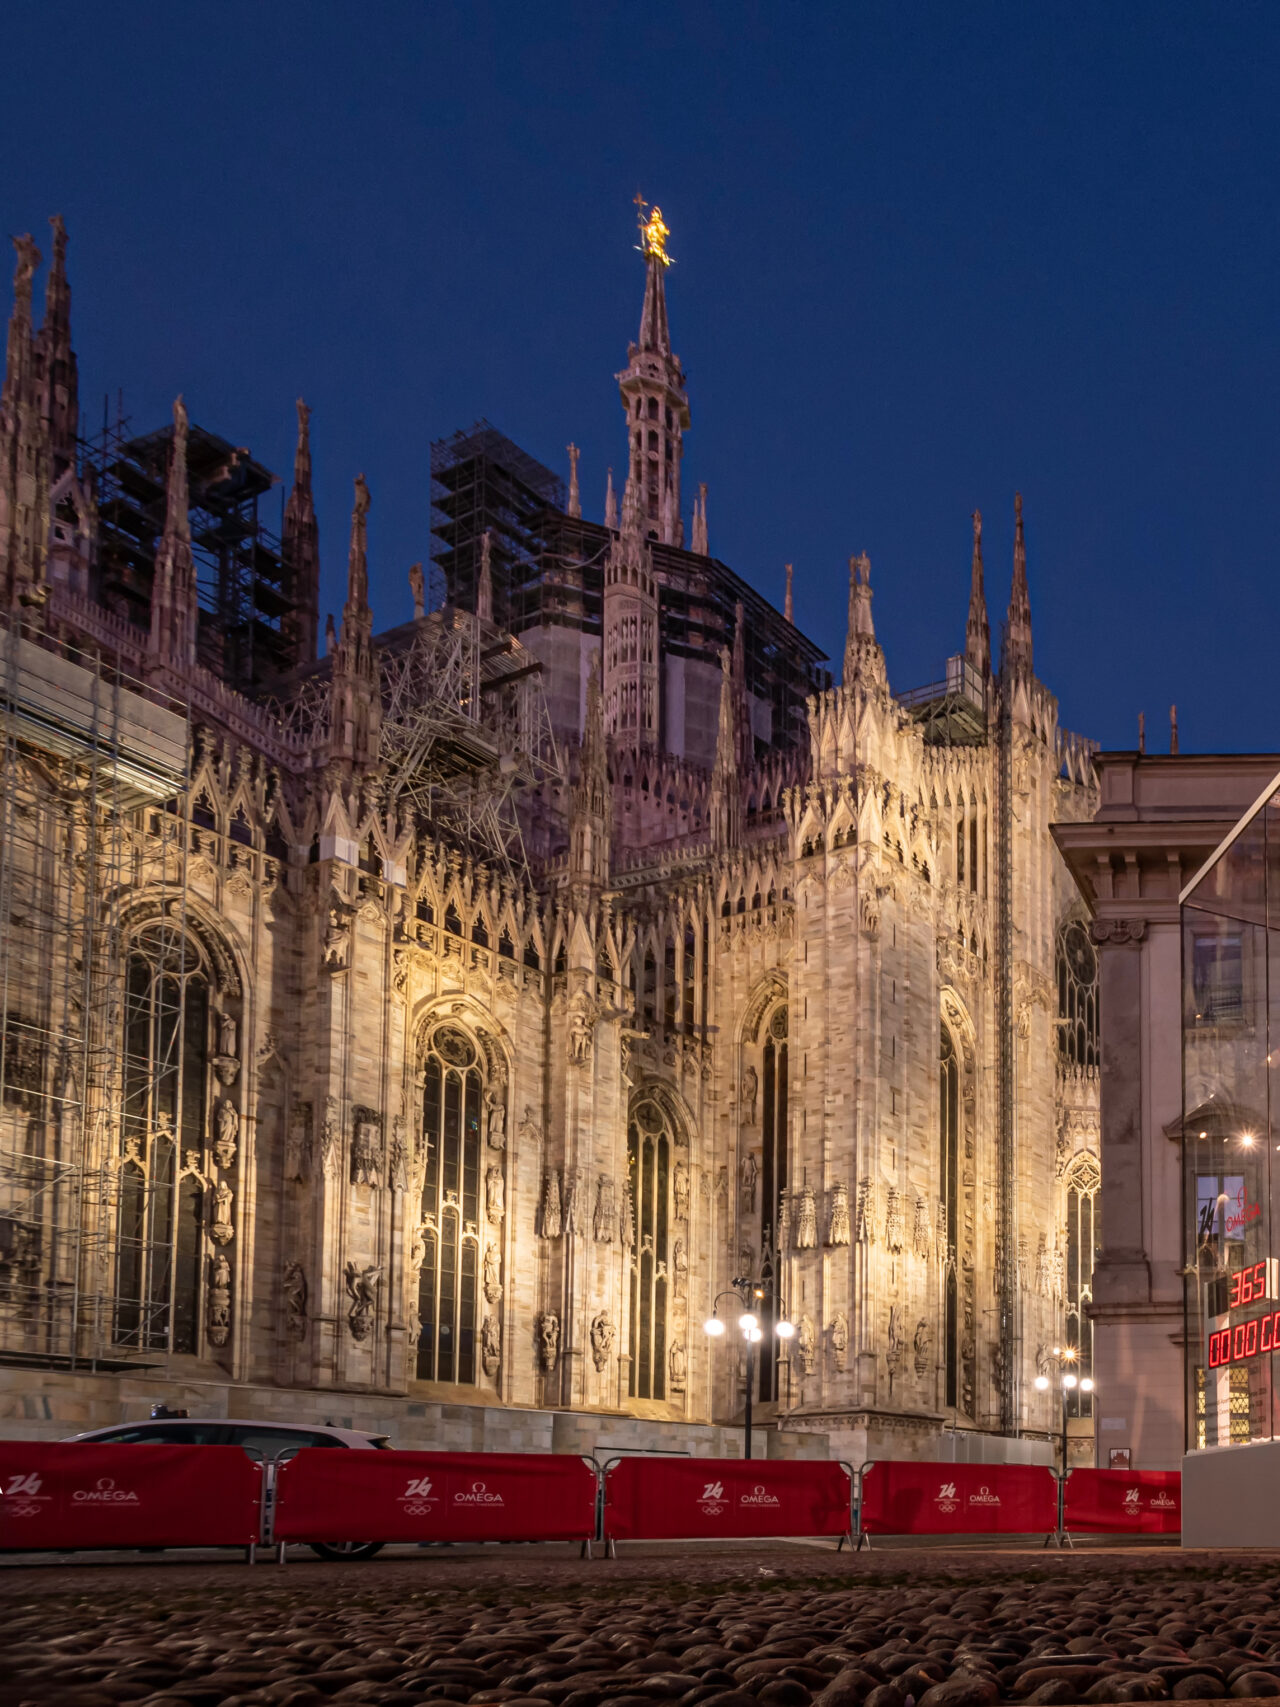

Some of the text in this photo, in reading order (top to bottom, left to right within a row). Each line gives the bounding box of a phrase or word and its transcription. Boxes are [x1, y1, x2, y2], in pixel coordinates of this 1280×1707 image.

[1225, 1202, 1261, 1232] OMEGA
[1230, 1262, 1266, 1308] 365
[72, 1490, 139, 1501] OMEGA
[454, 1493, 503, 1502] OMEGA
[741, 1495, 779, 1503] OMEGA
[1150, 1498, 1175, 1506] OMEGA
